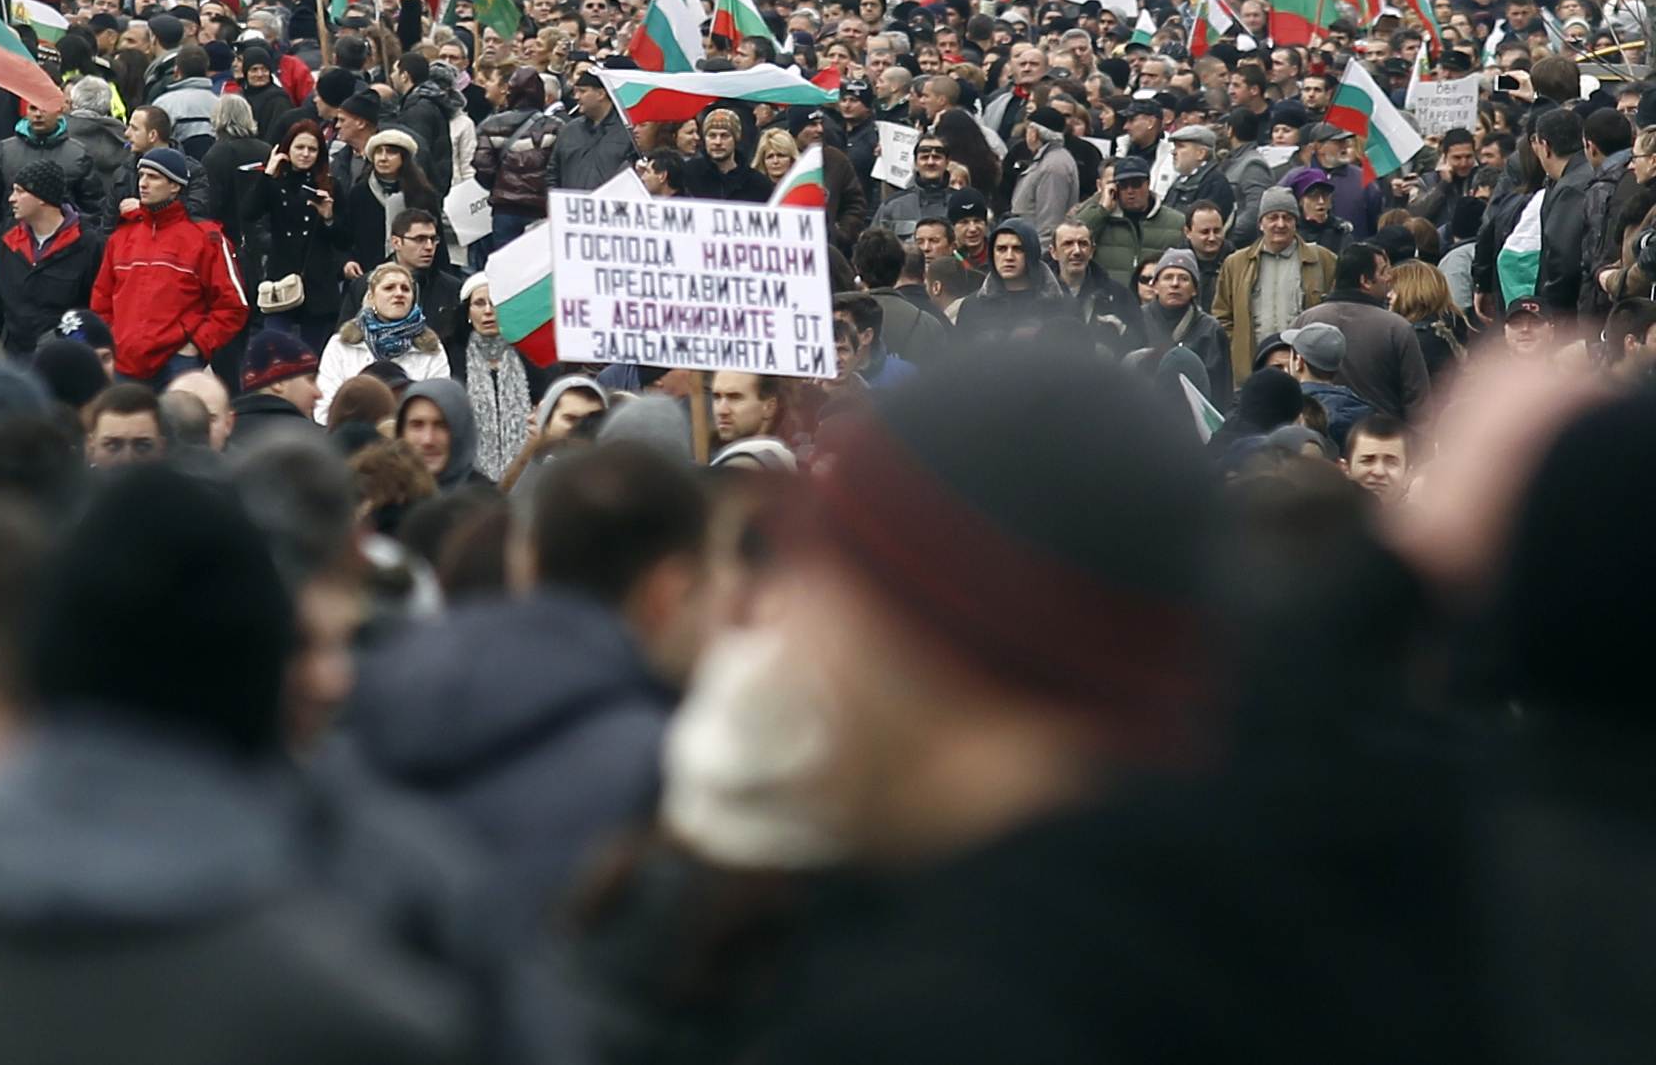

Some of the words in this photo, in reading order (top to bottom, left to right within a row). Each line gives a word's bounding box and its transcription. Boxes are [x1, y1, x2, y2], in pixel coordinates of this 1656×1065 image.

[565, 197, 694, 233] УВАЖАЕМИ
[713, 208, 781, 239] ДАМИ
[799, 214, 813, 240] И
[564, 232, 675, 268] ГОСПОДА
[702, 241, 816, 276] НАРОДНИ
[595, 267, 798, 310] ПРЕДСТАВИТЕЛИ,
[562, 299, 591, 328] НЕ
[612, 299, 776, 339] АБДИКИРАЙТЕ
[795, 314, 821, 342] ОТ
[593, 331, 777, 370] ЗАДЪЛЖЕНИЯТА
[794, 345, 826, 374] СИ
